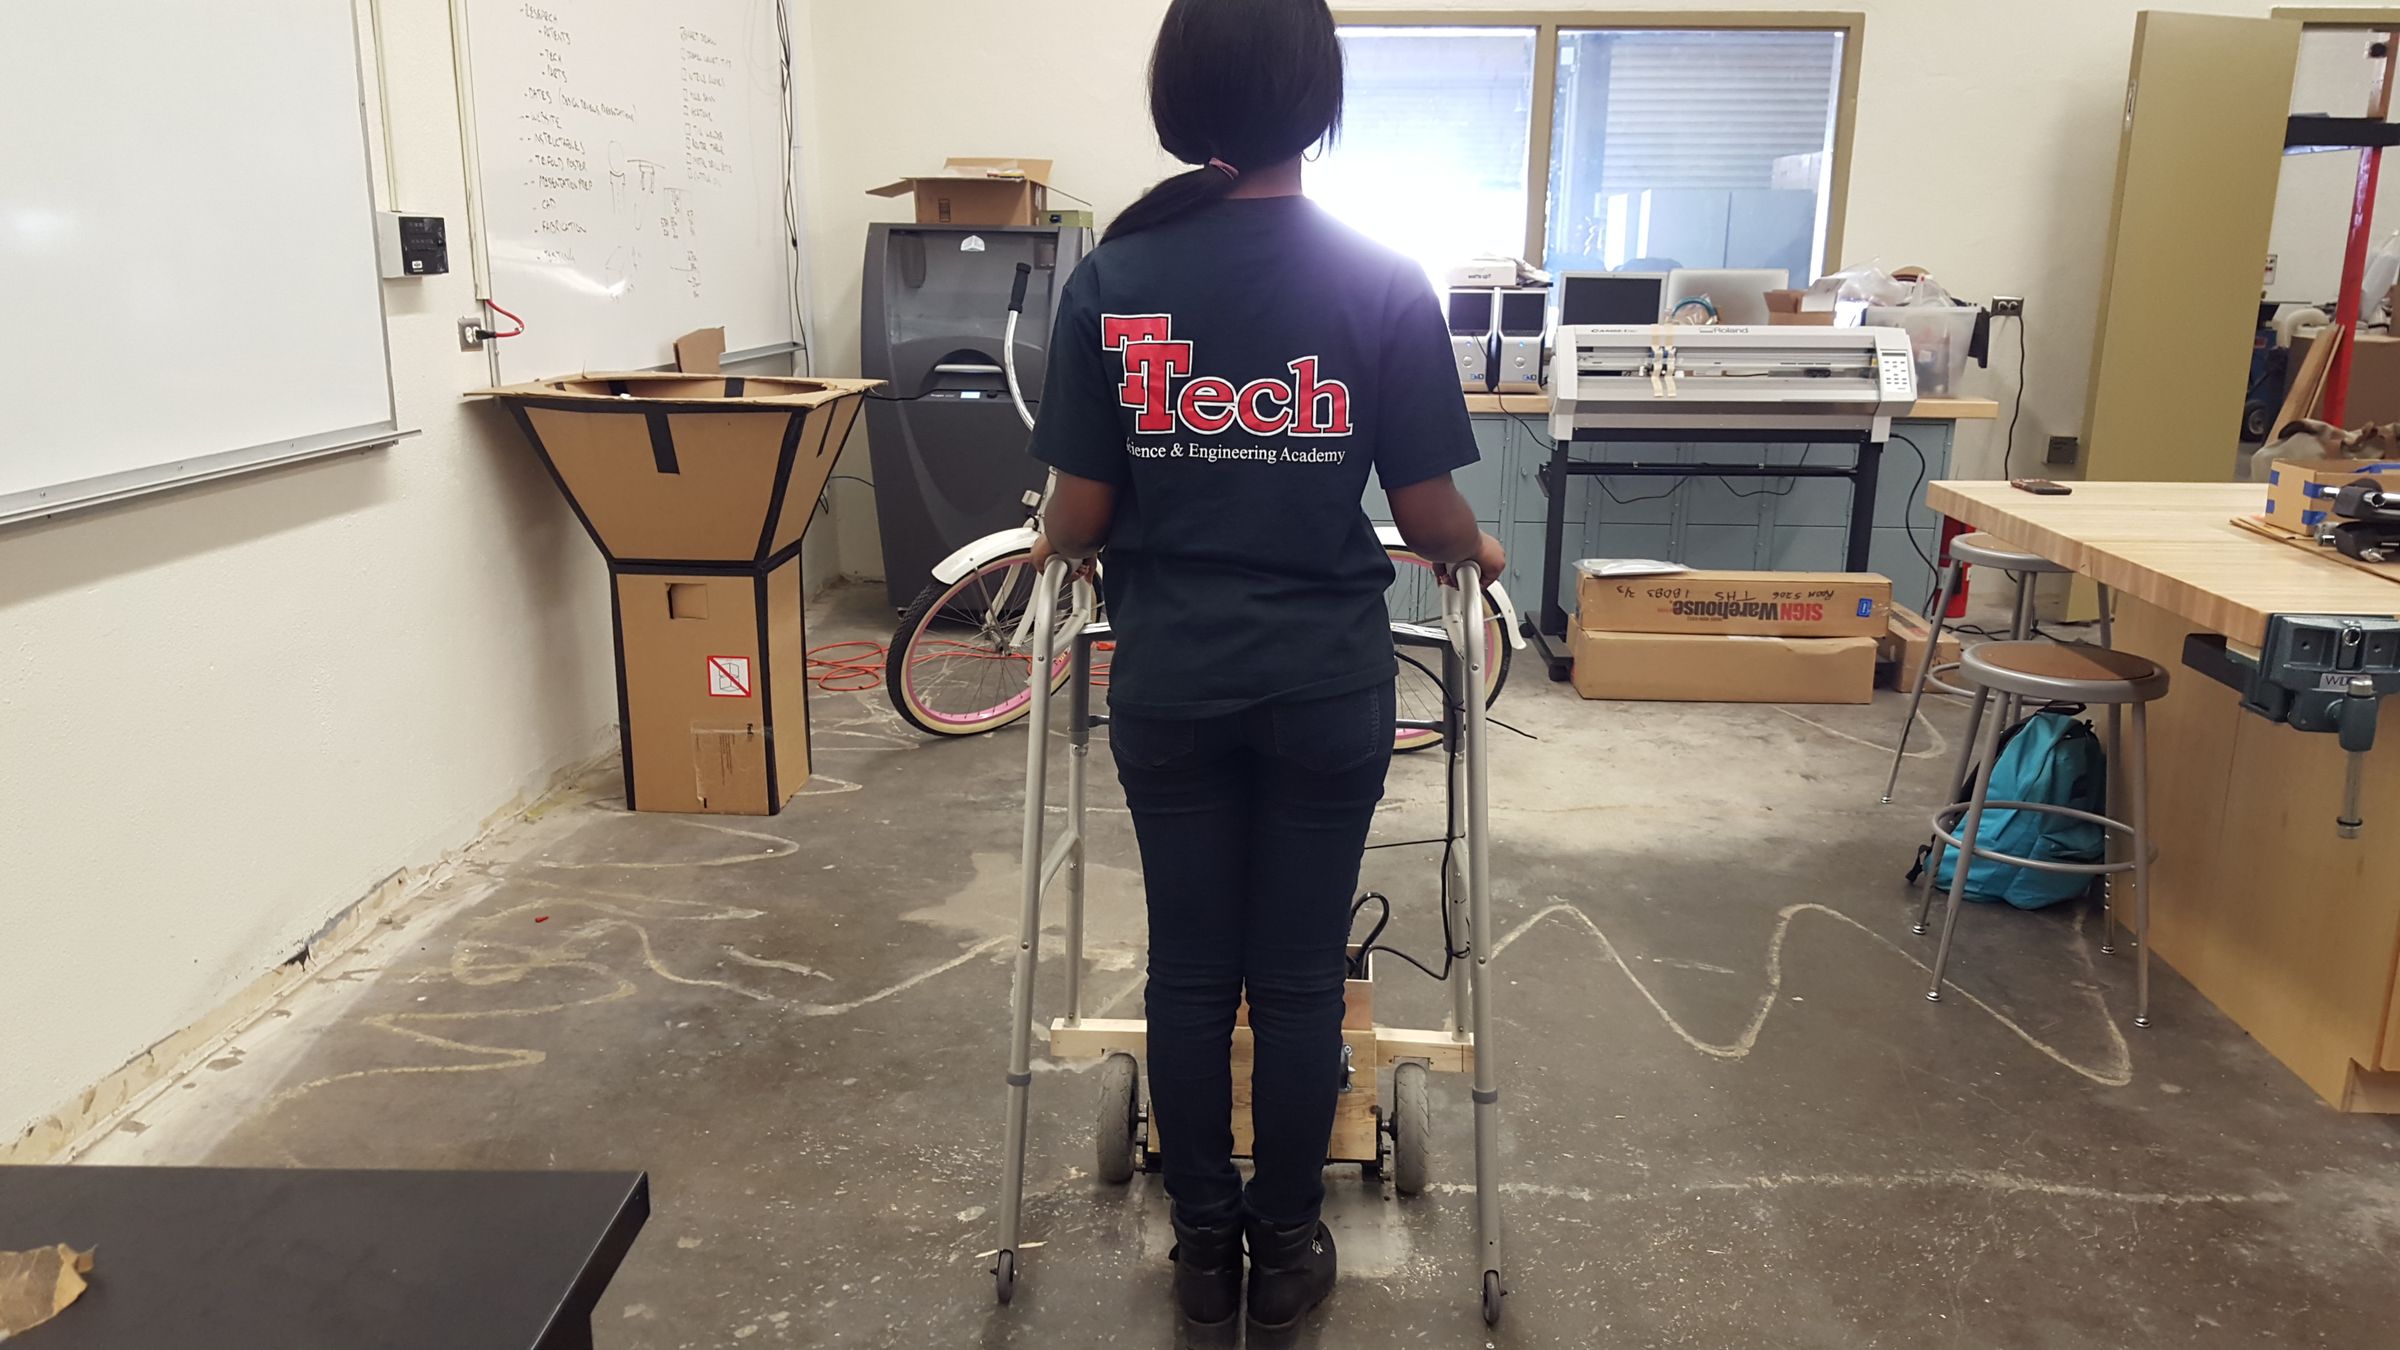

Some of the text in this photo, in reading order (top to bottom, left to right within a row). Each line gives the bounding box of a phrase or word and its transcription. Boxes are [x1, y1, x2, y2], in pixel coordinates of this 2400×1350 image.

[1170, 443, 1184, 458] &
[1188, 443, 1277, 463] Engineering
[1280, 446, 1346, 465] Academy
[1714, 590, 1757, 602] THS
